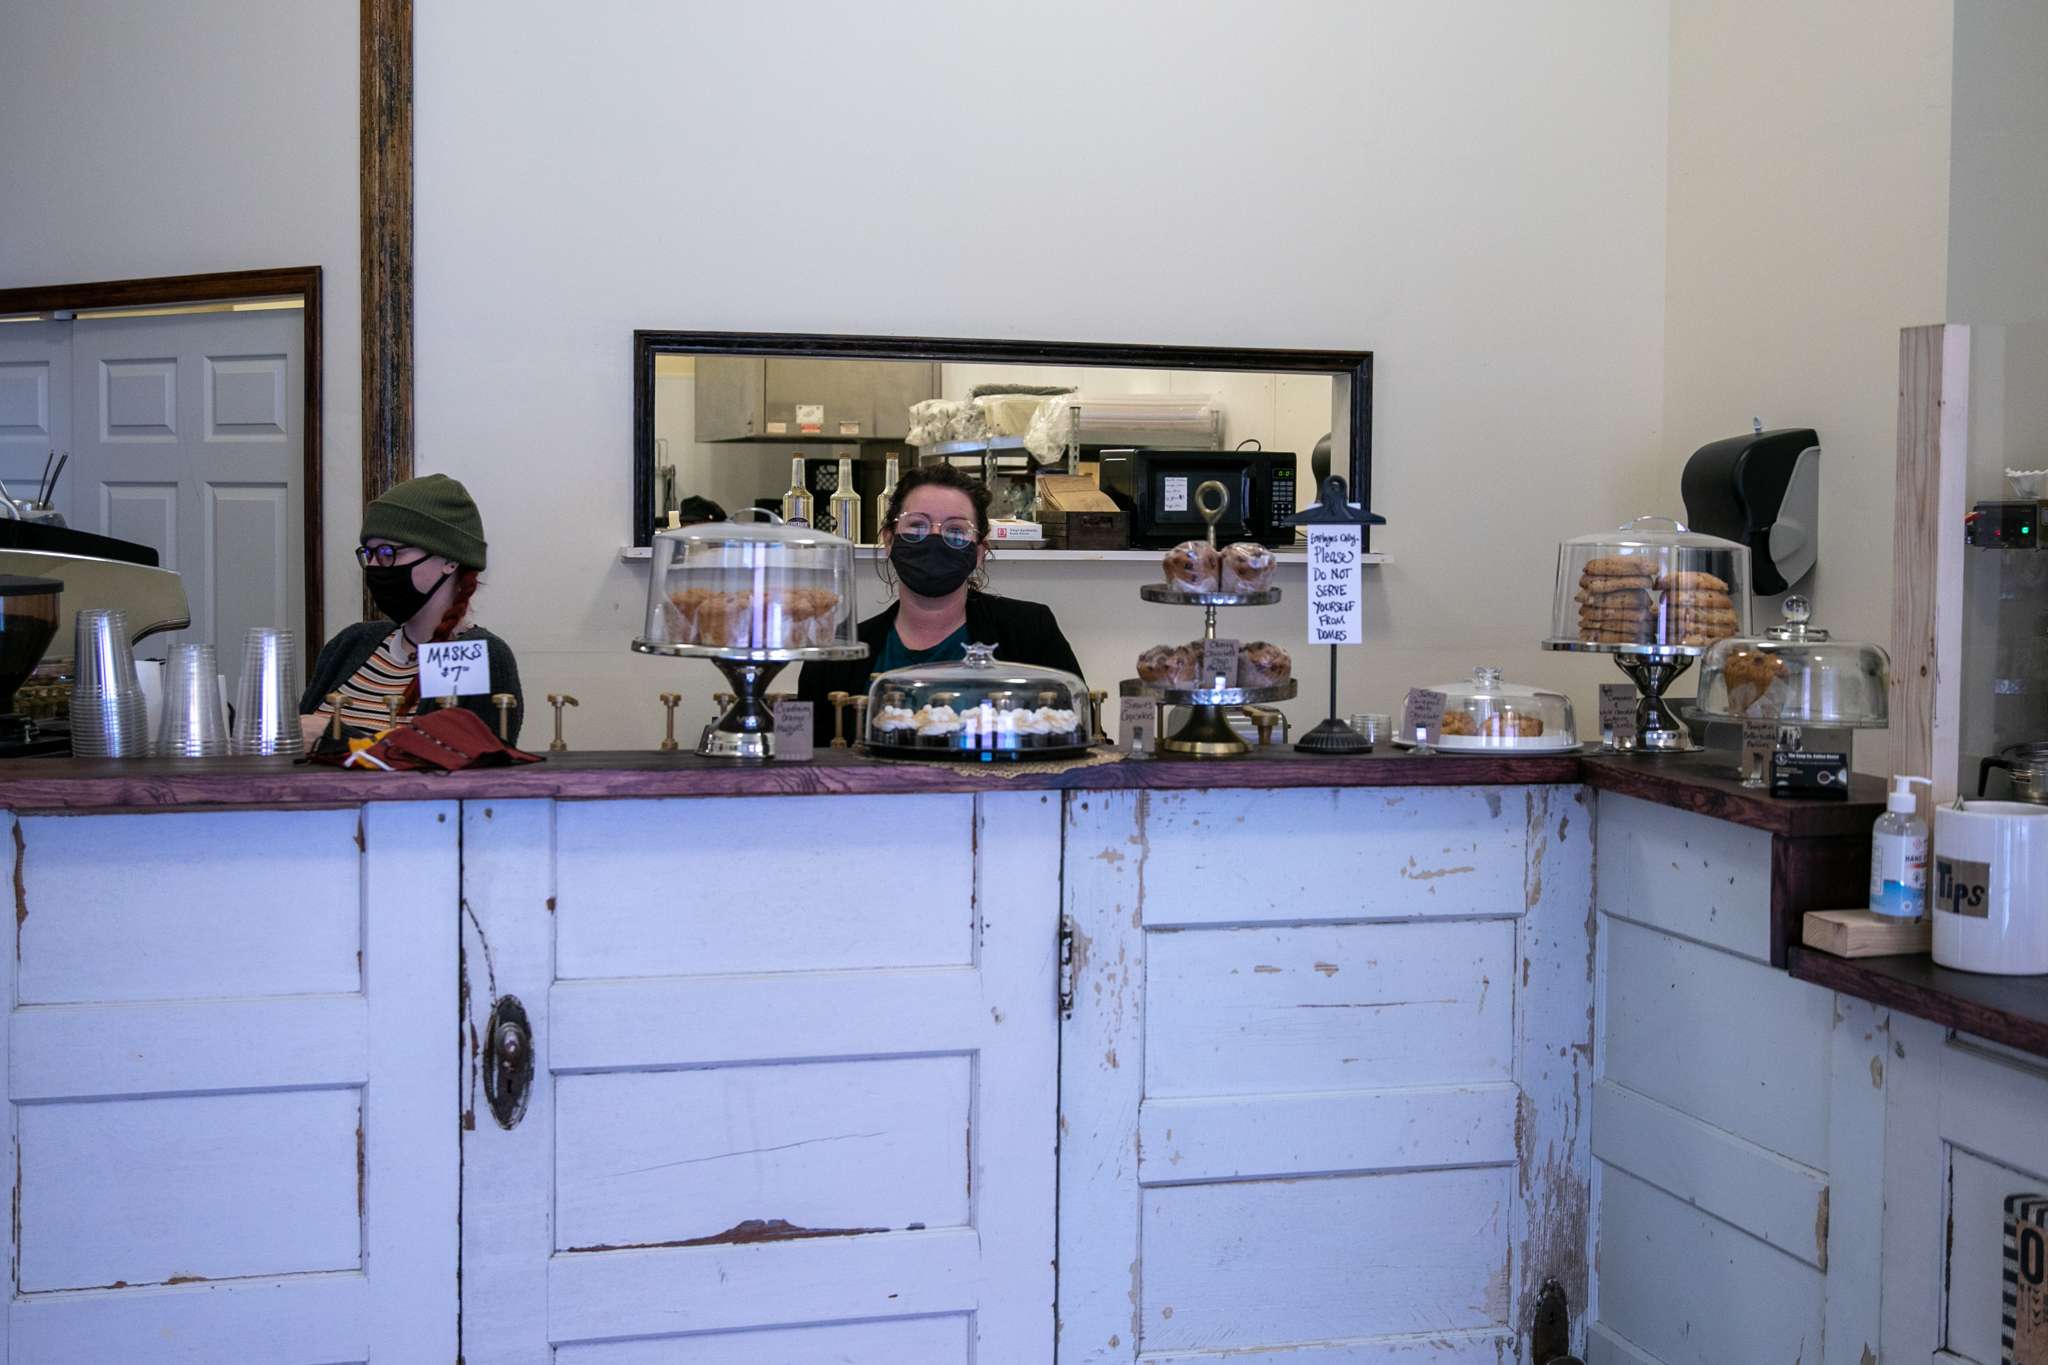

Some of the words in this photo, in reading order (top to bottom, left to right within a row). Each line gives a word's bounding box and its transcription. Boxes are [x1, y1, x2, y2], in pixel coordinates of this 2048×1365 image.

[1314, 546, 1354, 564] Please
[1331, 567, 1352, 580] NOT
[1315, 584, 1348, 598] SERVE
[1312, 600, 1356, 615] YOURSELF
[1318, 614, 1346, 627] FROM
[1316, 628, 1348, 641] DOMES
[426, 643, 483, 668] MASKS
[1936, 861, 1985, 914] Tips
